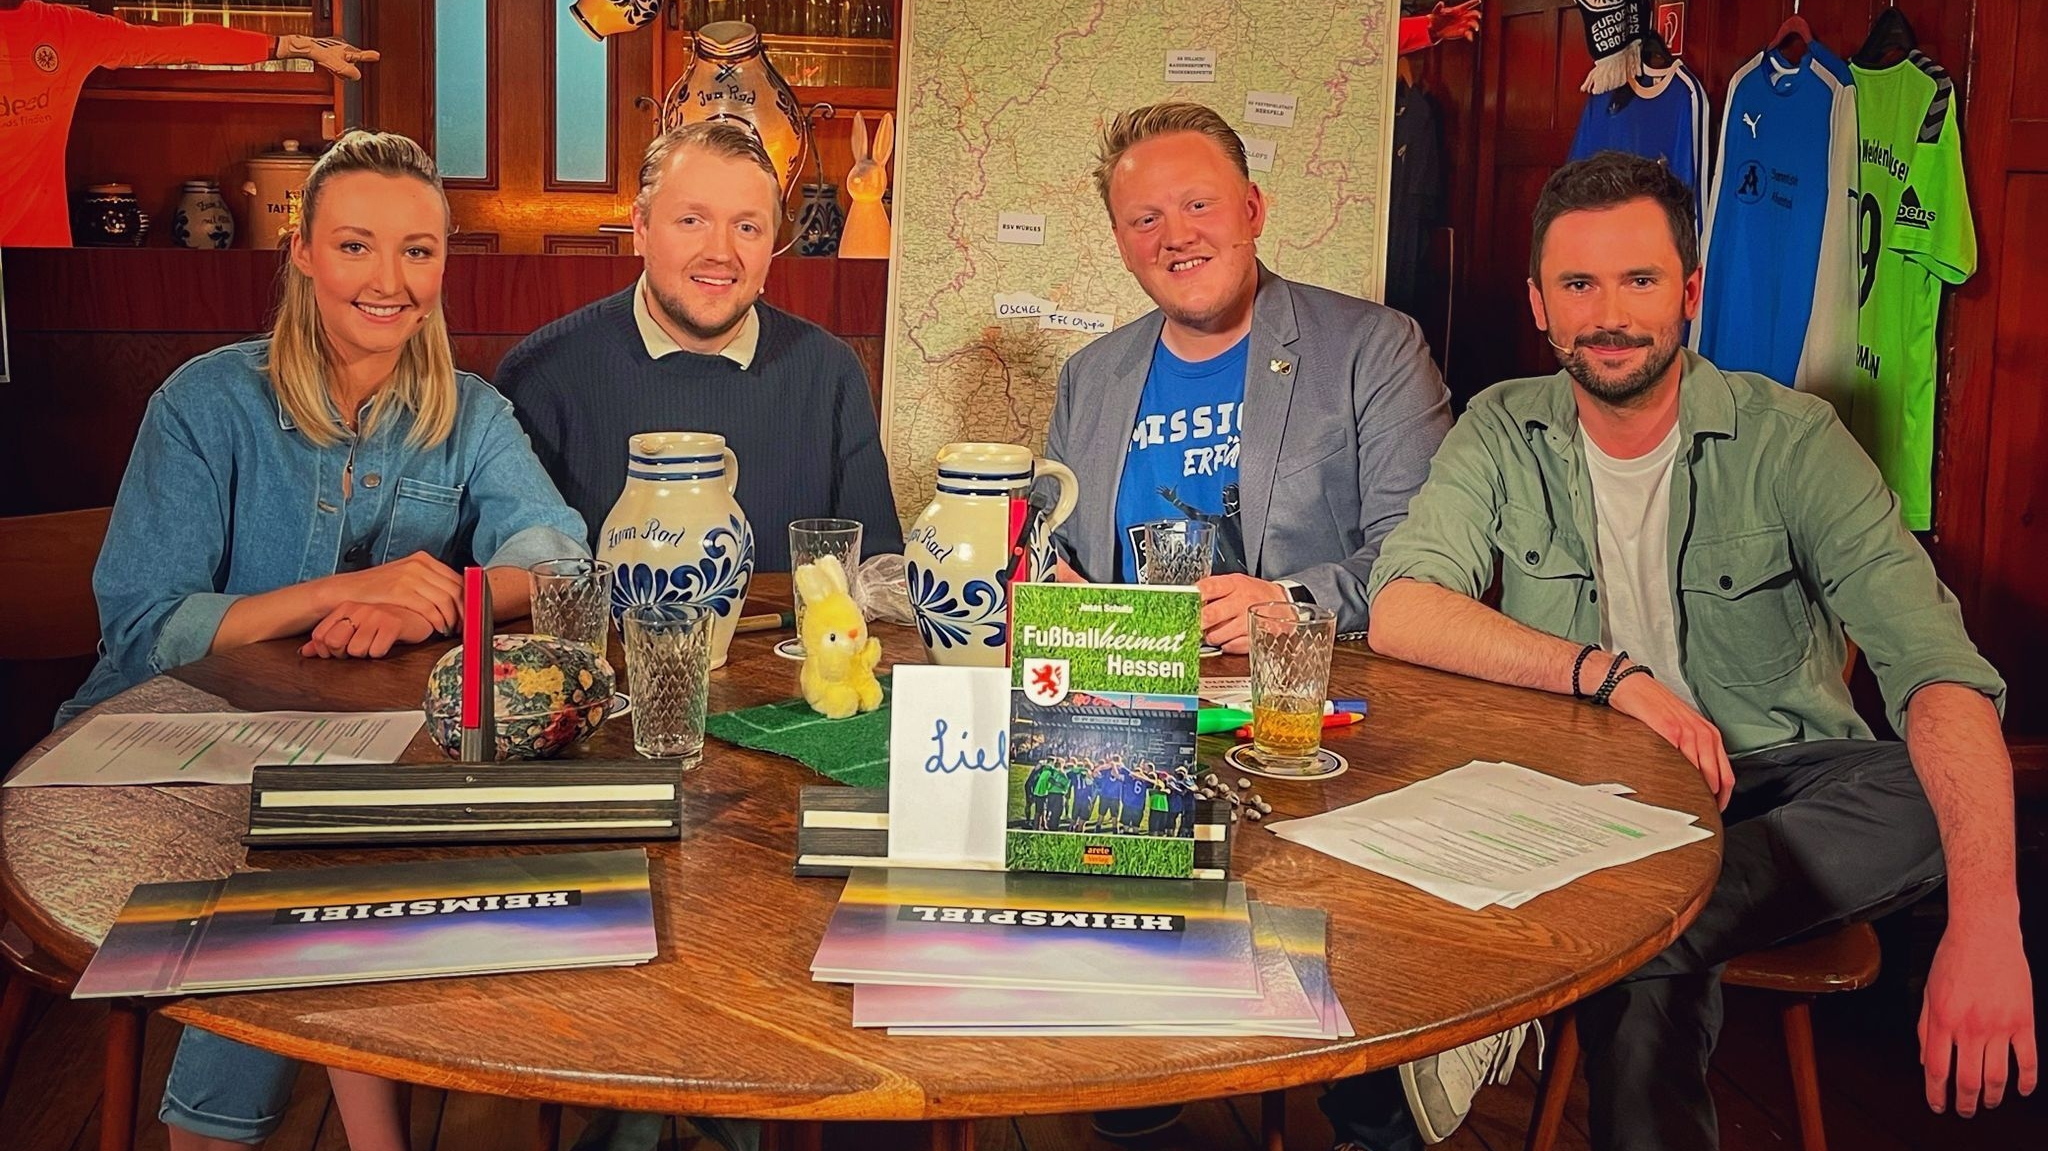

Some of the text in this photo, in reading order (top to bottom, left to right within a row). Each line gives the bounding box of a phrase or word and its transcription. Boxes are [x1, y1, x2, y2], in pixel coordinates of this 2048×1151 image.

[640, 517, 686, 549] Rad
[1022, 621, 1189, 654] Fußballheimat
[1106, 653, 1185, 679] Hessen
[290, 891, 570, 923] HEIMSPIEL
[912, 906, 1174, 931] HEIMSPIEL
